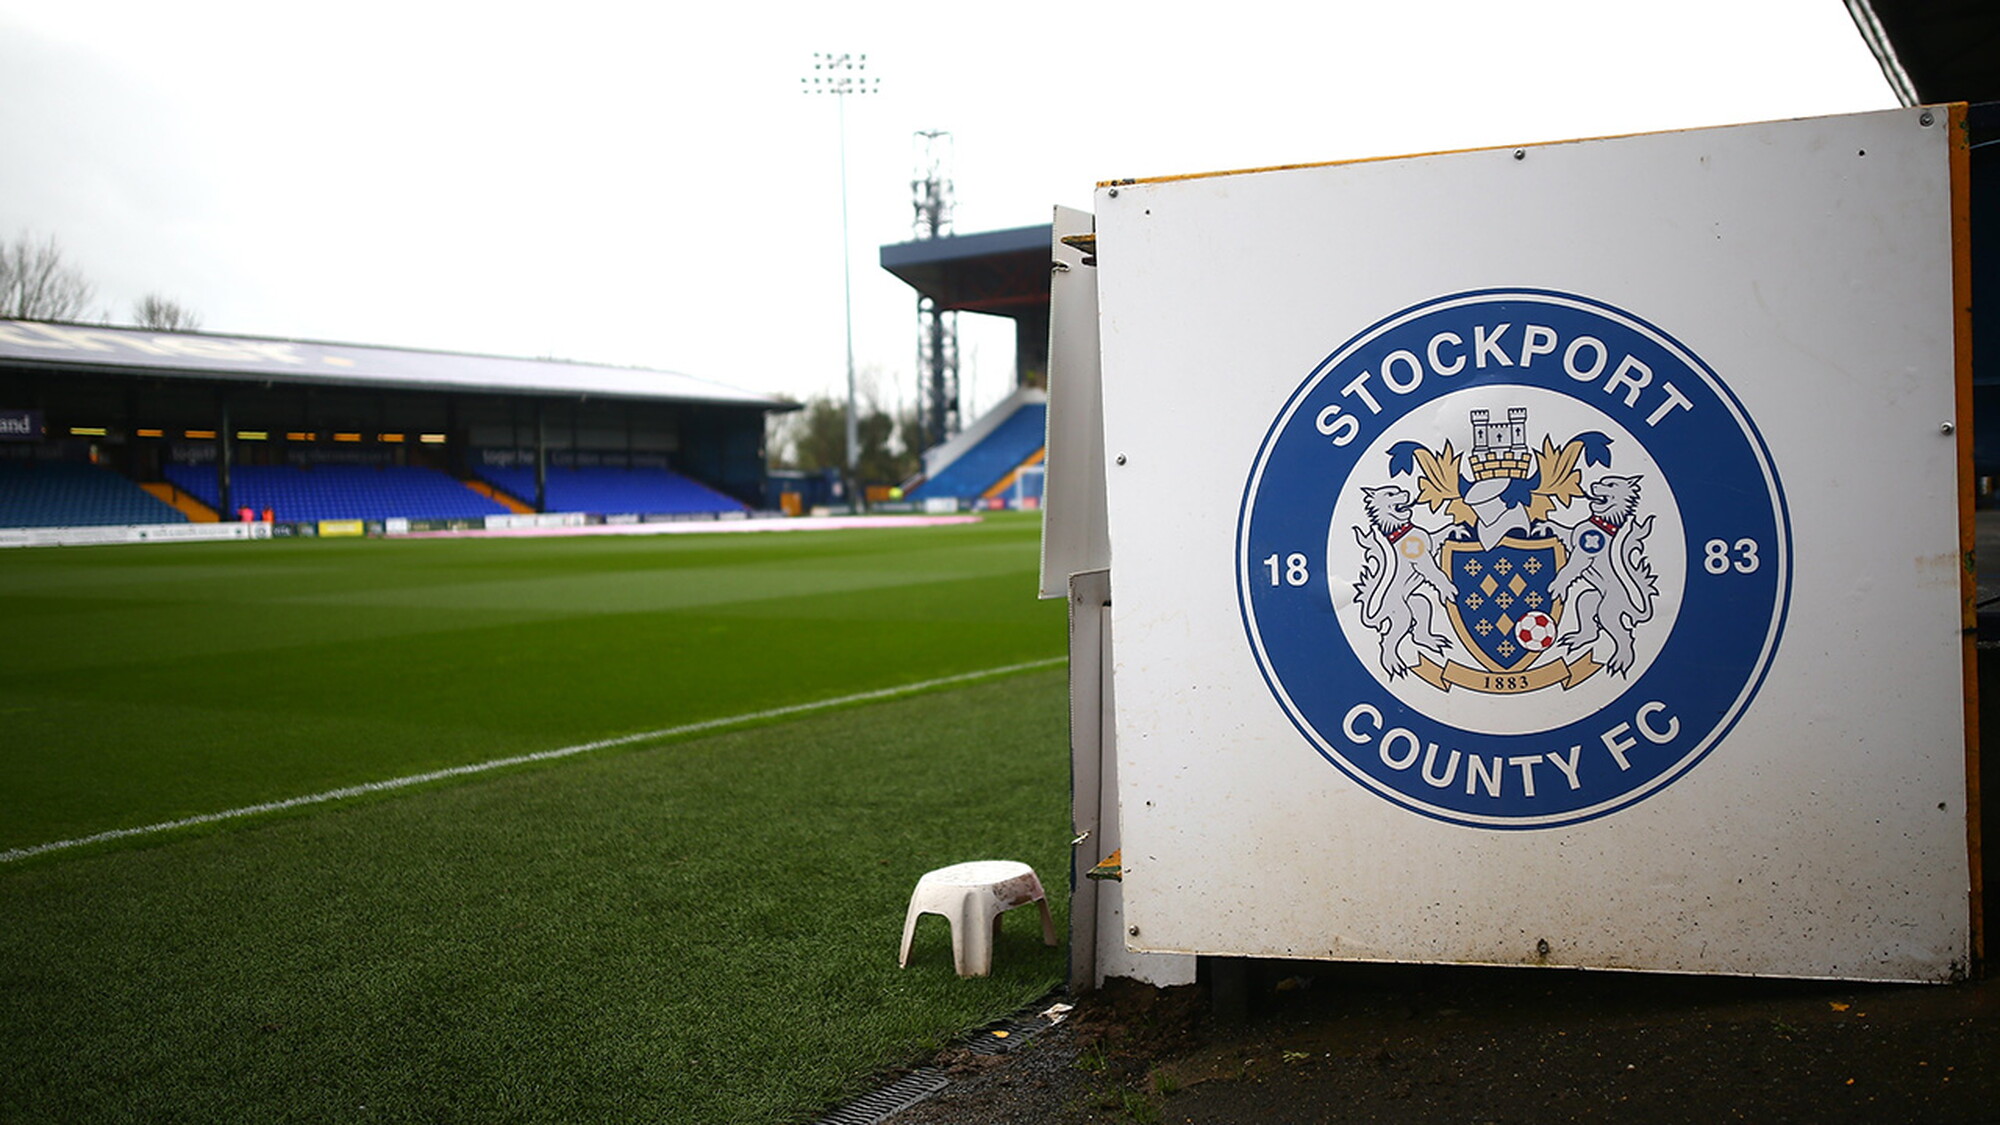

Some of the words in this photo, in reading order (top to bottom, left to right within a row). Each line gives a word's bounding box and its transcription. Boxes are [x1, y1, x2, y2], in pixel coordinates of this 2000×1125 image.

[1315, 323, 1694, 447] STOCKPORT
[1263, 553, 1309, 586] 18
[1704, 538, 1760, 575] 83
[1484, 675, 1529, 690] 1883
[1342, 703, 1583, 798] COUNTY
[1601, 700, 1681, 772] FC
